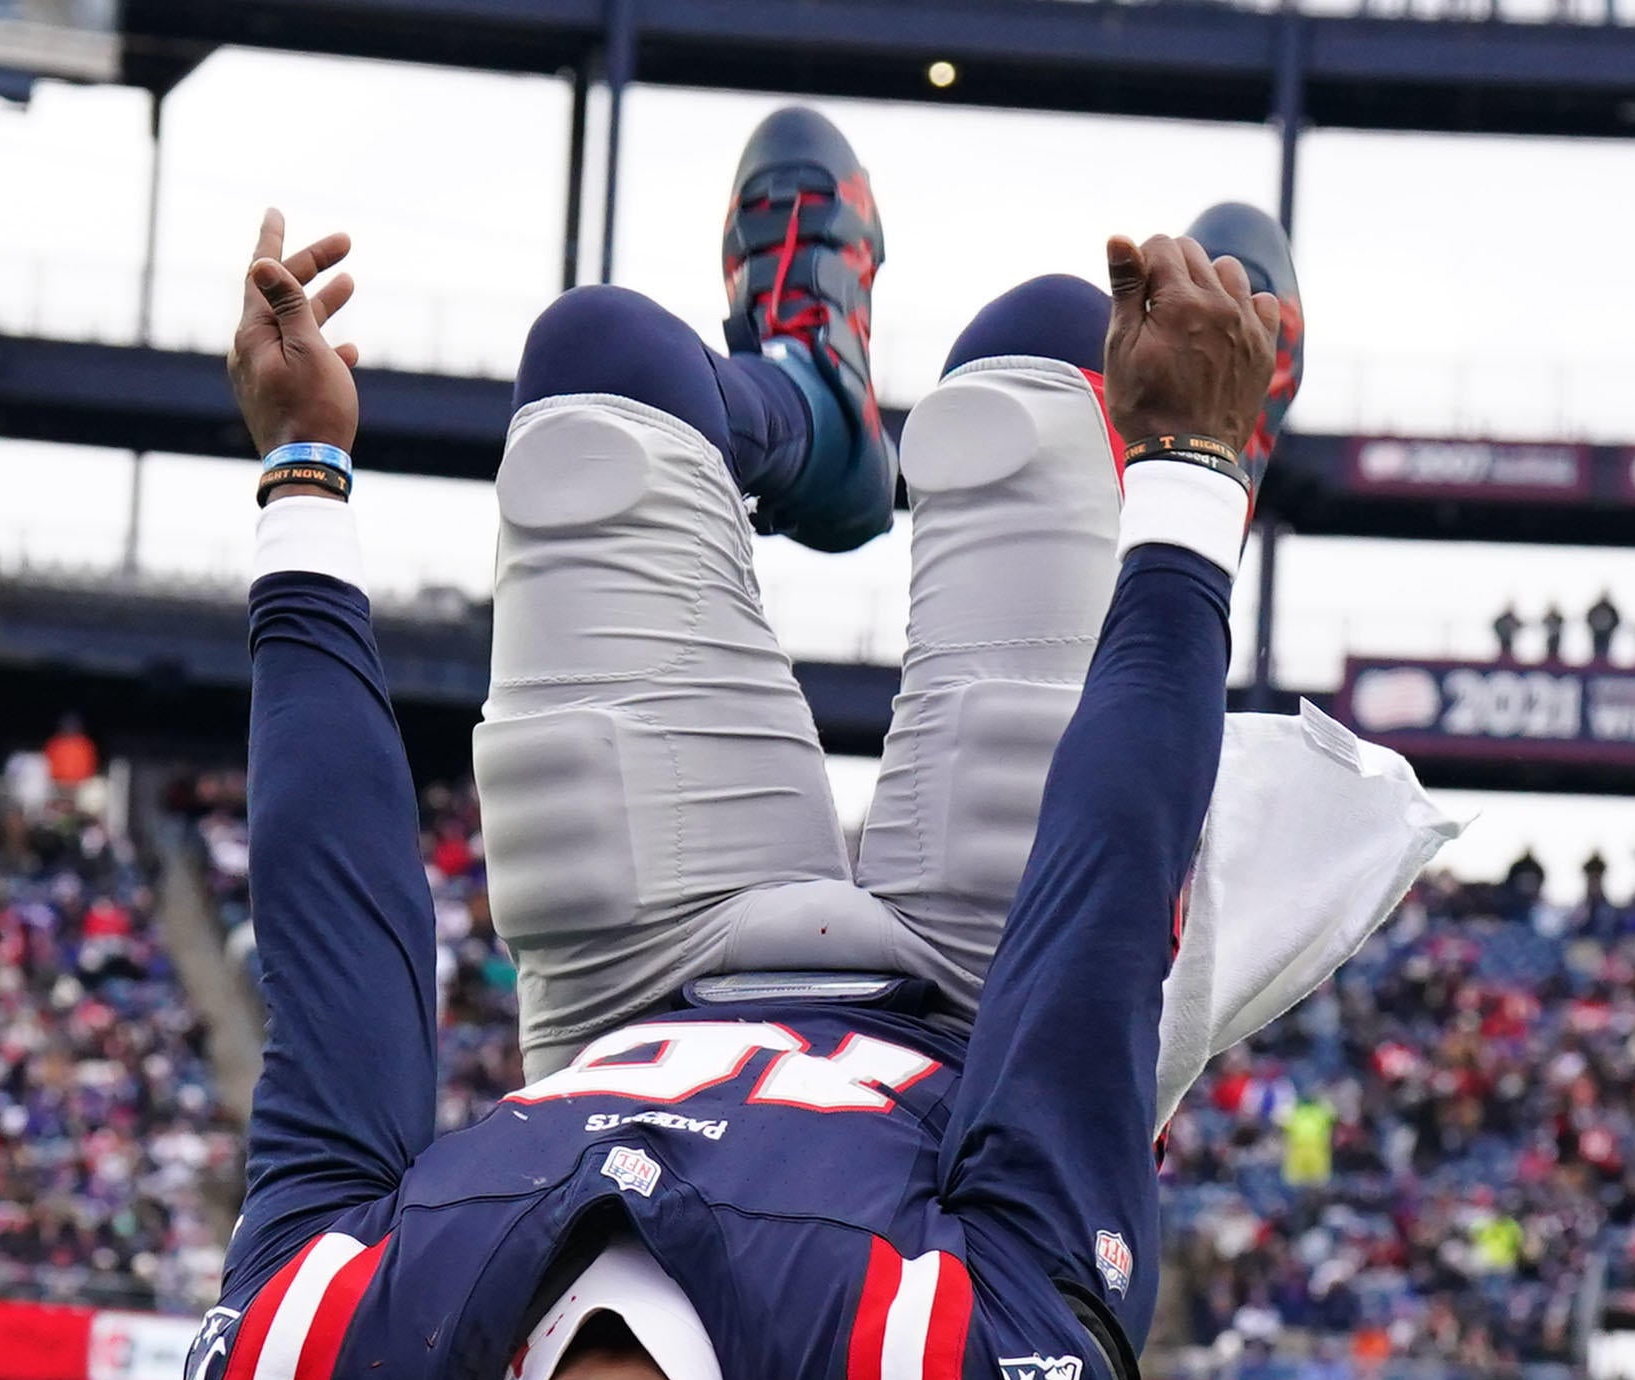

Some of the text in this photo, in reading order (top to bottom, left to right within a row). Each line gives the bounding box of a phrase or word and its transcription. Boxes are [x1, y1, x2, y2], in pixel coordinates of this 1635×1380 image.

[1442, 669, 1582, 738] 2021
[618, 1152, 652, 1180] NFL
[1100, 1236, 1130, 1277] NFL
